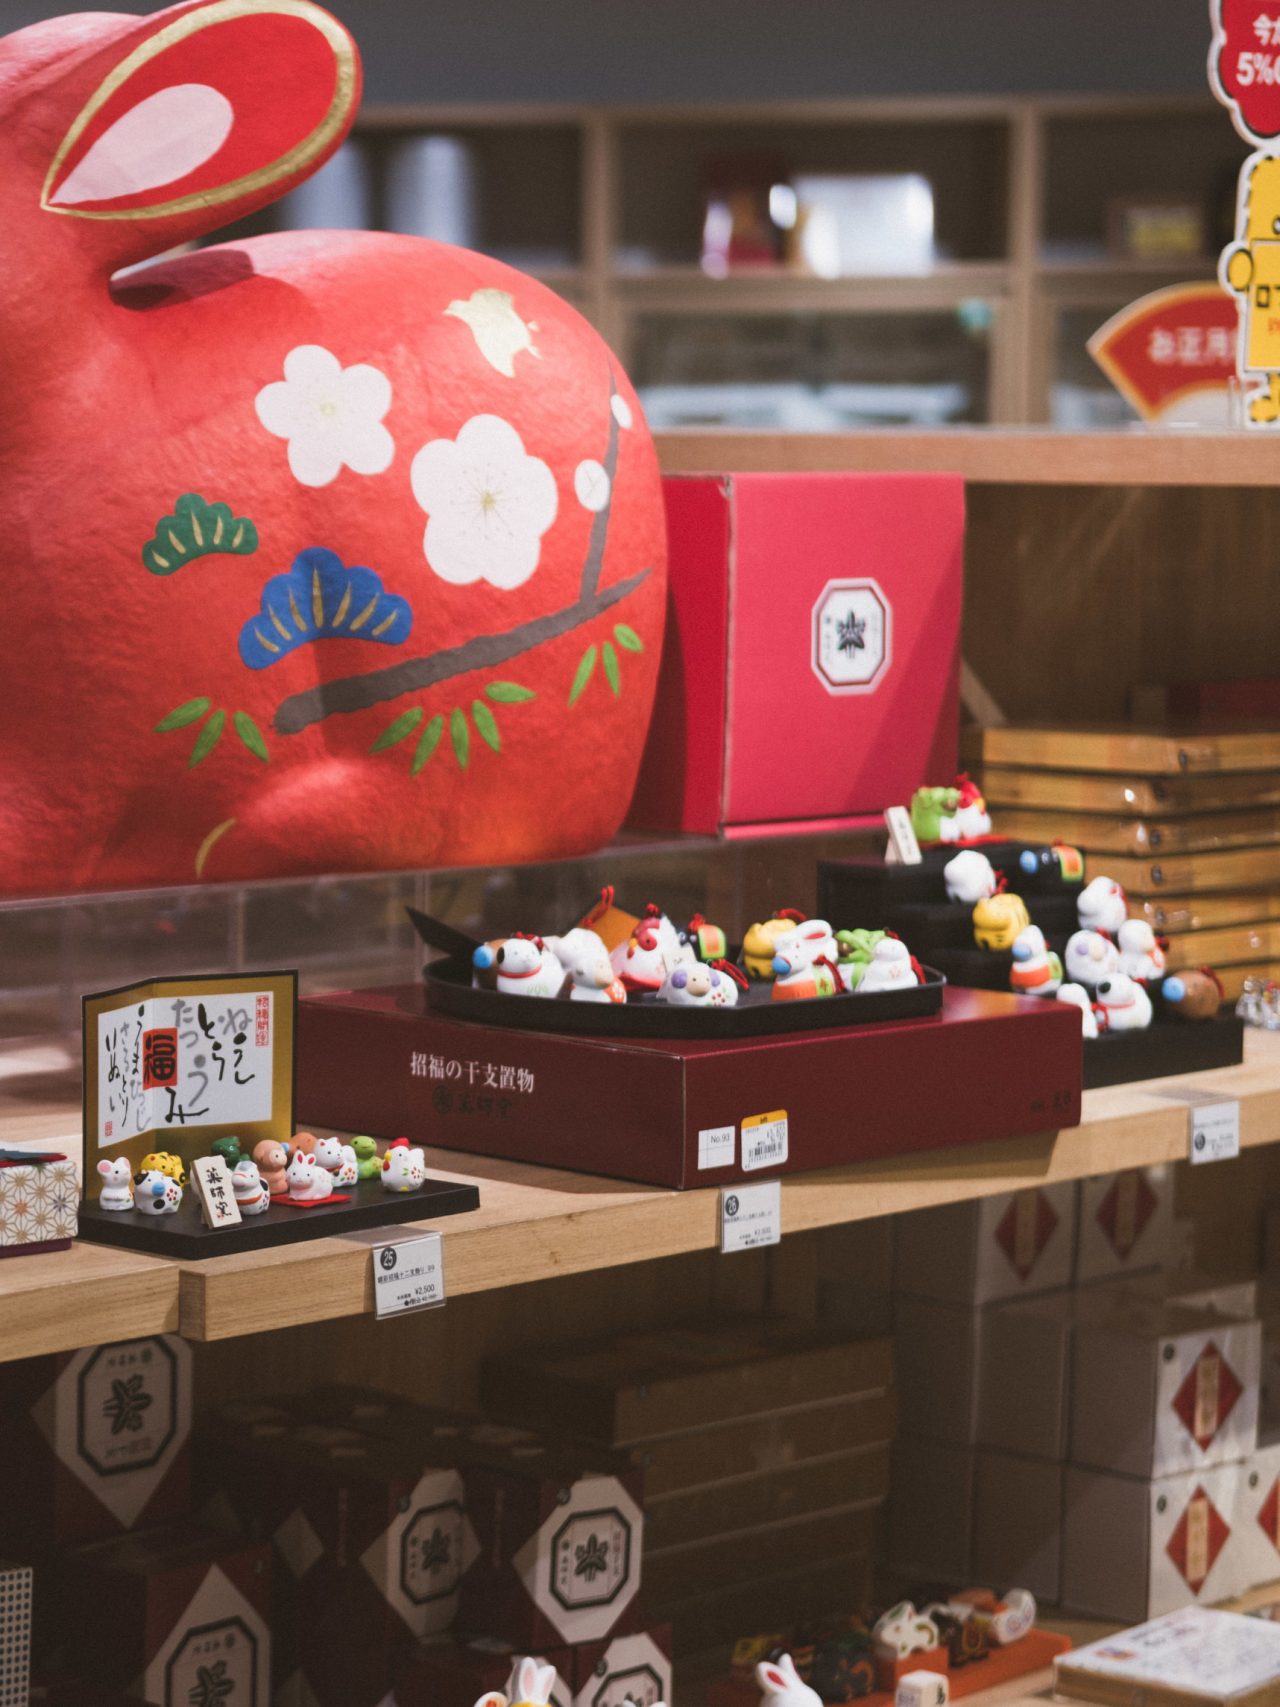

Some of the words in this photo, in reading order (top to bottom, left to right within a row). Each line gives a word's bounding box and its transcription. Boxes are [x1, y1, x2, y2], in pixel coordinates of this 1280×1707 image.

[1256, 285, 1280, 309] ロ
[1146, 326, 1237, 367] お正月
[410, 1051, 535, 1093] 招福の干支置物
[383, 1250, 394, 1267] 25
[415, 1284, 435, 1295] ¥2,500
